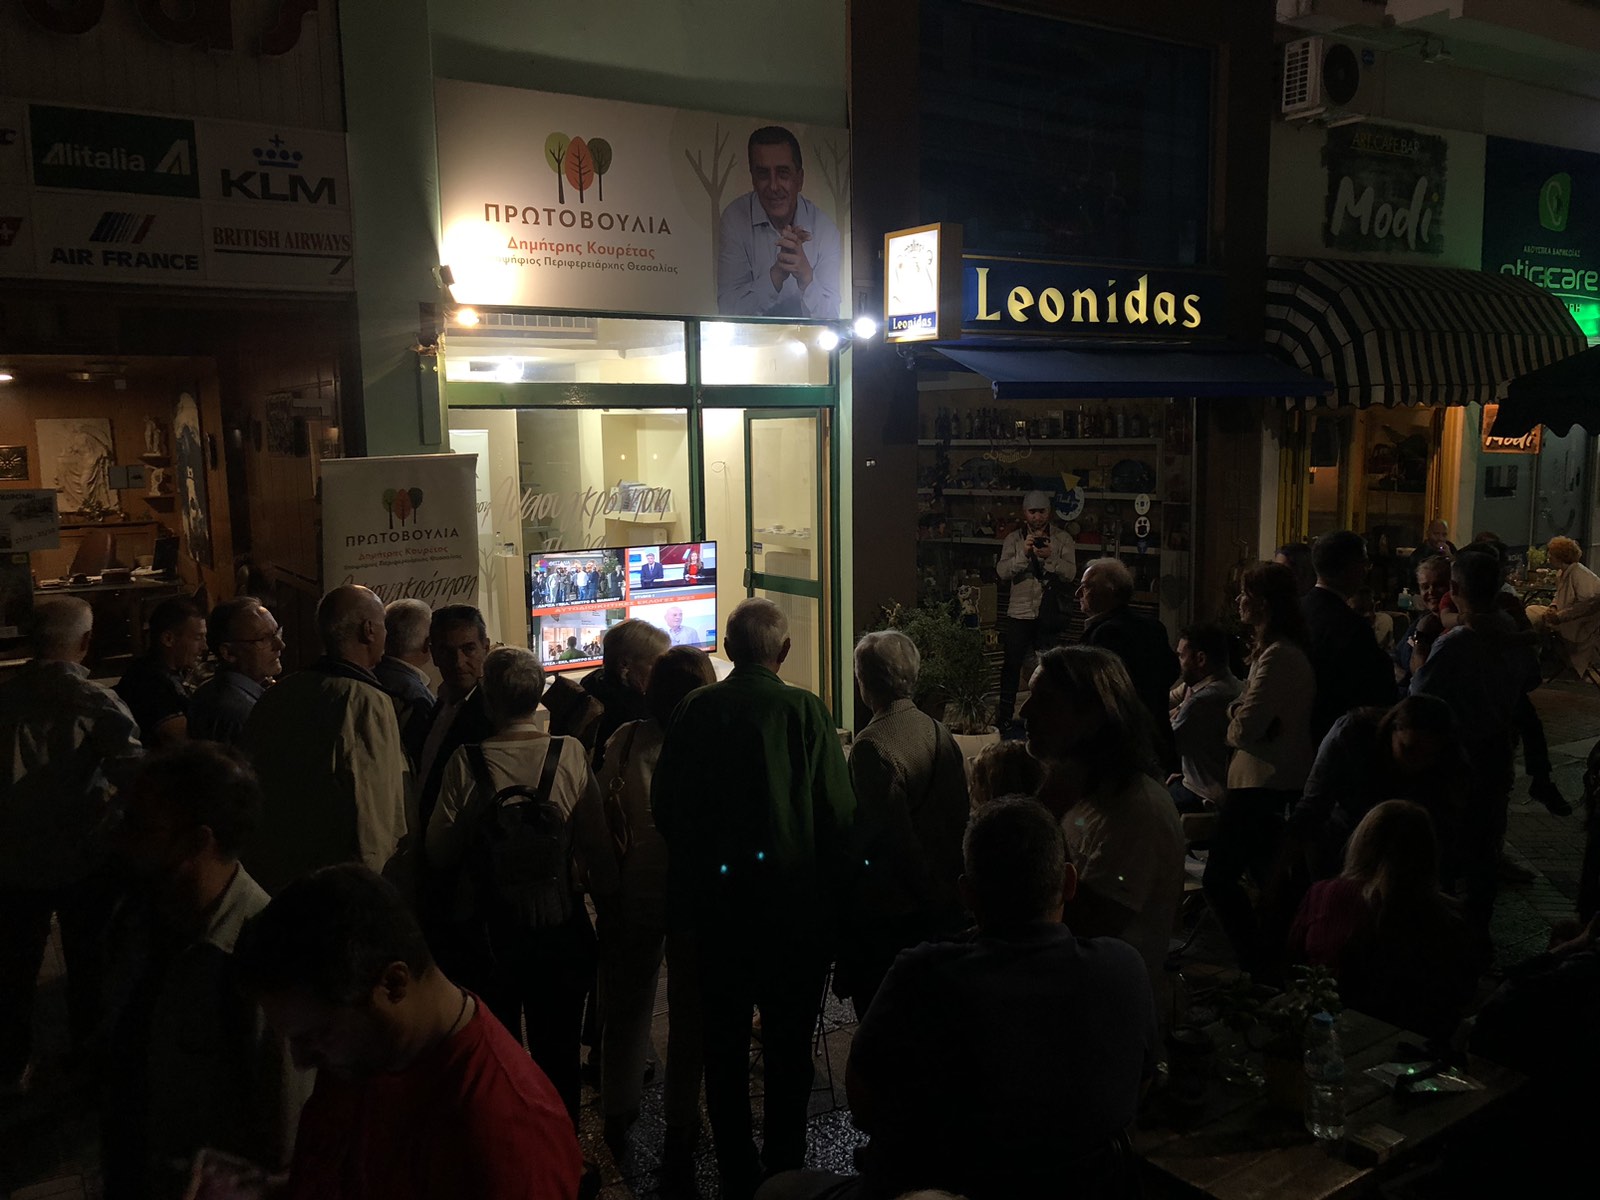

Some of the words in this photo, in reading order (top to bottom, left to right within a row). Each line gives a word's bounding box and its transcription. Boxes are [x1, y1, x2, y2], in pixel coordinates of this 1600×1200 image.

[42, 142, 146, 172] Alitalia
[220, 168, 337, 204] KLM
[484, 203, 672, 235] ΠΡΩΤΟΒΟΥΛΙΑ
[1330, 175, 1439, 250] Modi
[213, 226, 280, 249] BRITISH
[284, 231, 351, 252] AIRWAYS
[507, 236, 583, 256] Δημήτρης
[587, 240, 656, 260] Κουρέτας
[50, 247, 95, 266] AIR
[103, 249, 200, 271] FRANCE
[543, 256, 625, 272] Περιφερειάρχης
[627, 261, 679, 275] Θεσσαλίας
[975, 267, 1202, 328] Leonidas
[892, 314, 933, 331] Leonidas
[345, 527, 460, 547] ΠΡΩΤΟΒΟΥΛΙΑ
